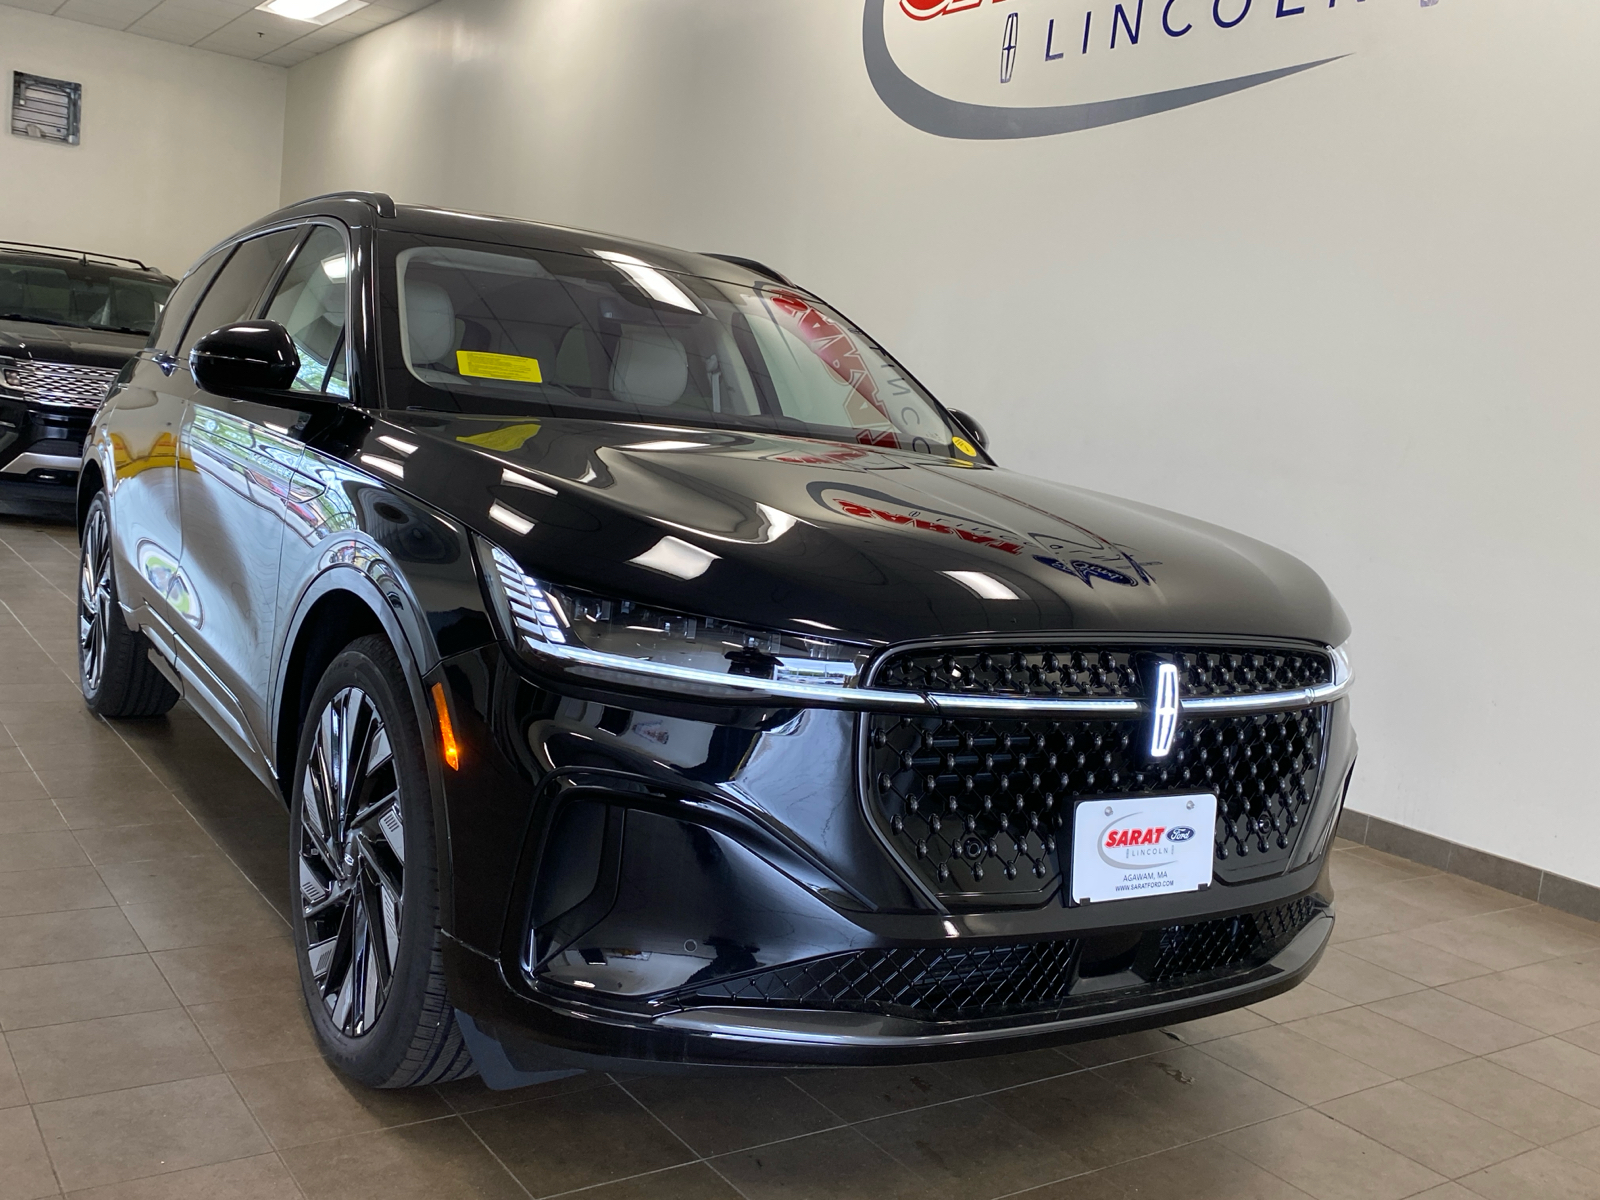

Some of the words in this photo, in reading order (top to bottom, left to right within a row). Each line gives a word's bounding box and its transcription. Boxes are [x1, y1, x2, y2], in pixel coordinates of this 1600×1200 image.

[1045, 0, 1366, 61] LINCOL
[1105, 826, 1166, 848] SARAT
[1131, 847, 1168, 857] LINCOLN
[1122, 872, 1155, 882] AGAWAM,
[1157, 871, 1168, 879] MA
[1115, 880, 1174, 892] WWW.SARATFORD.COM
